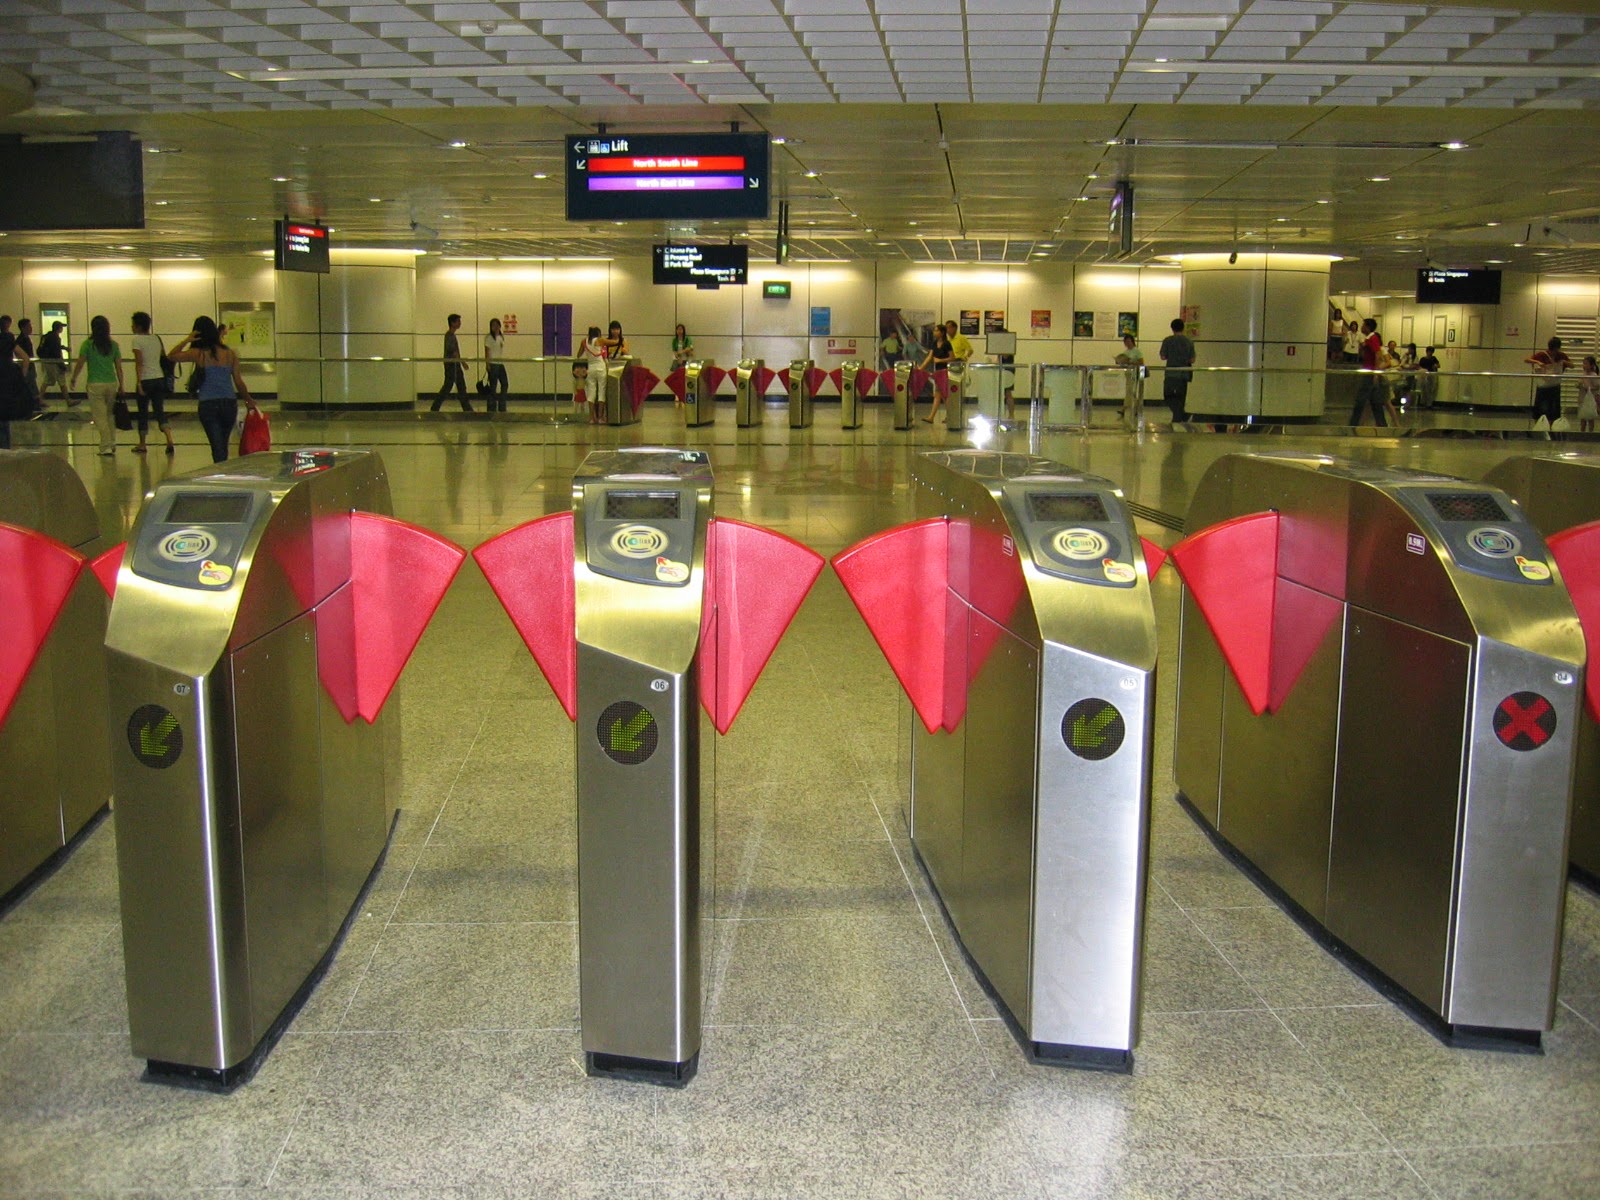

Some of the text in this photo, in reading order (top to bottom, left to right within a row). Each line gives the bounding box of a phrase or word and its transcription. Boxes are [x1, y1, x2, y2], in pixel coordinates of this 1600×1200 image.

[611, 140, 629, 152] Lift
[633, 158, 698, 168] North South Line
[636, 179, 659, 188] North
[655, 681, 665, 690] 06
[1124, 678, 1135, 686] 05
[176, 685, 186, 693] 07
